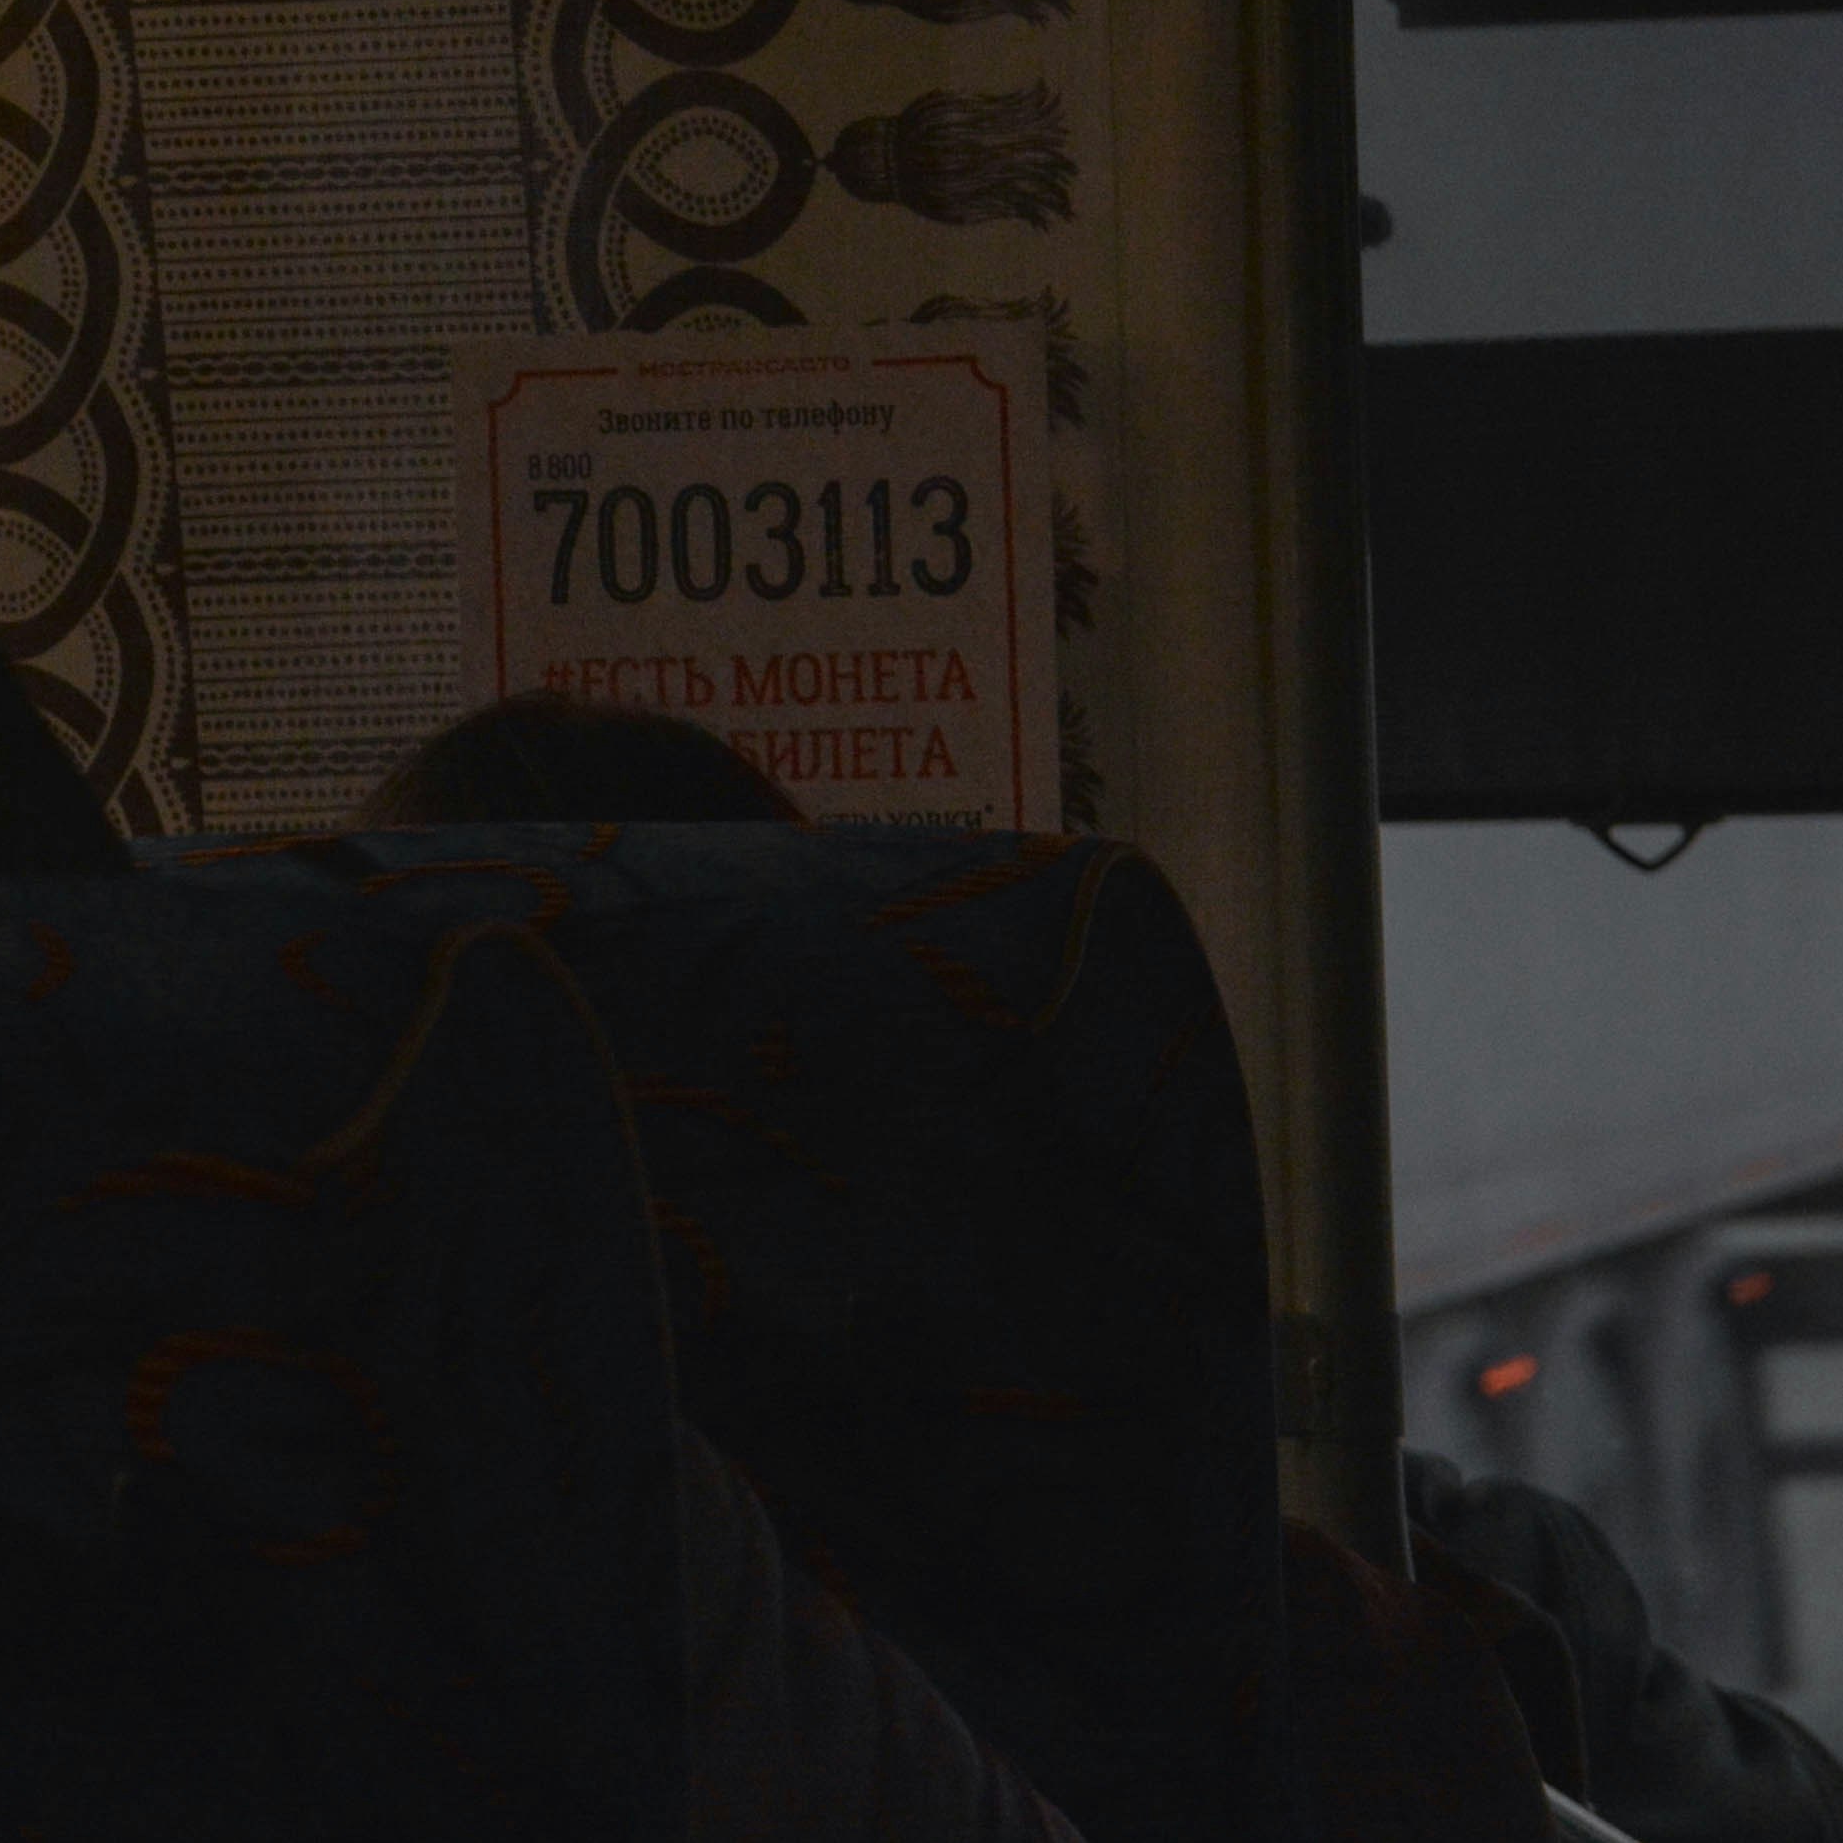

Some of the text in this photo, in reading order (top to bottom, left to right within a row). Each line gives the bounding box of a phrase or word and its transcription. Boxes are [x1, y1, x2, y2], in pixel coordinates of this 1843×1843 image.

[598, 398, 896, 435] Звоните по телефону
[527, 452, 593, 480] 8 800
[533, 475, 973, 605] 7003113
[731, 646, 977, 709] МОНЕТА
